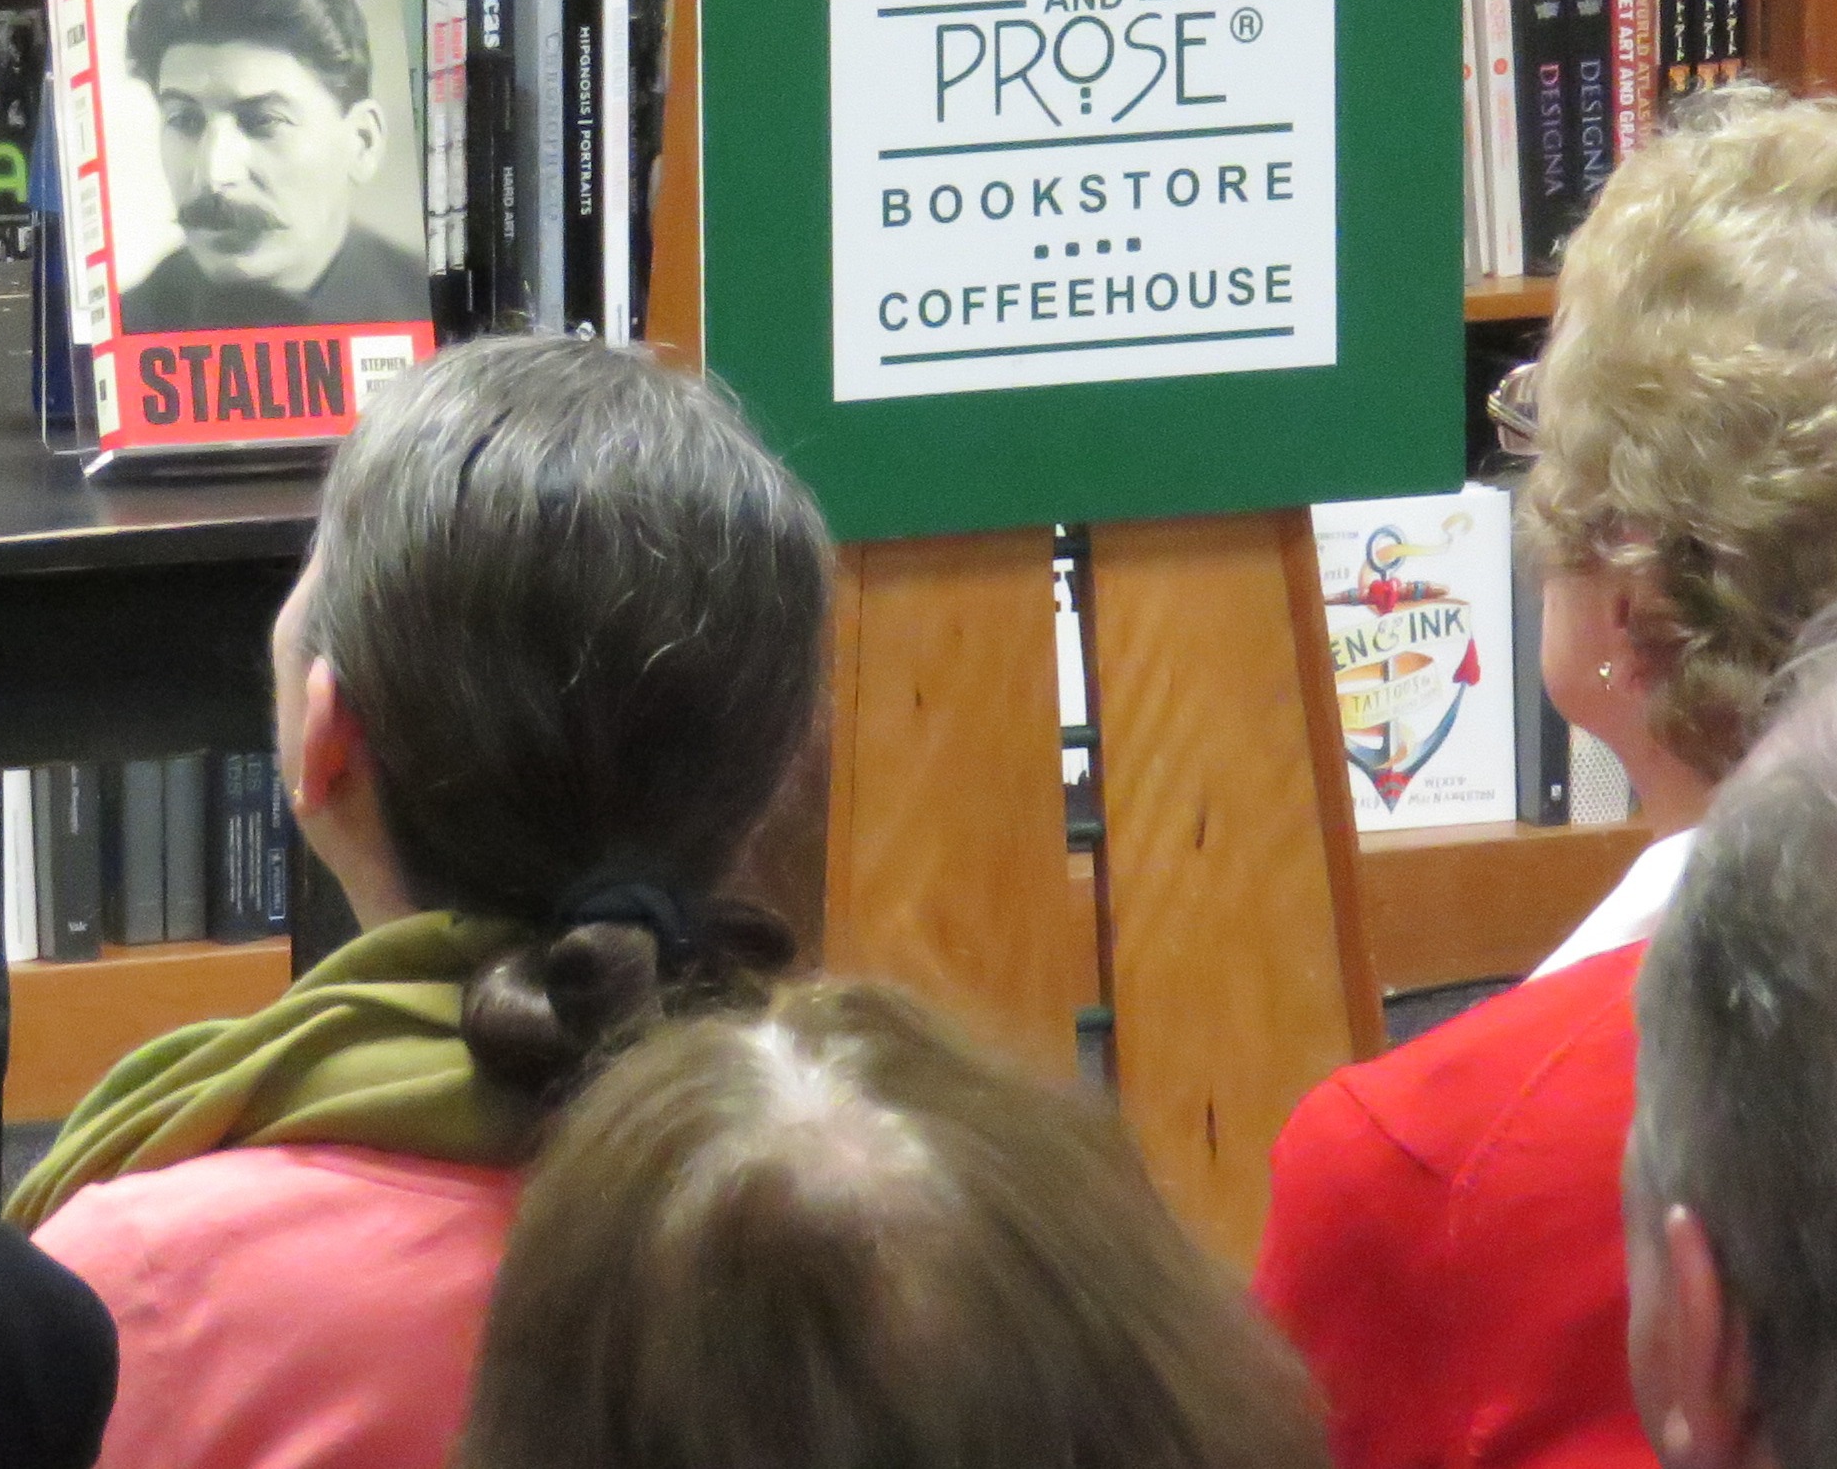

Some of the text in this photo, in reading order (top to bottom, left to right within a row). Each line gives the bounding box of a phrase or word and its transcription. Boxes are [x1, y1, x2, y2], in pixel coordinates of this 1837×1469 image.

[1619, 25, 1634, 62] ART
[1620, 67, 1635, 106] AND
[579, 25, 593, 217] HIPGNOSIS PORTRAITS
[1538, 62, 1564, 197] DESIGNA
[1579, 59, 1605, 194] DESIGNA
[882, 161, 1294, 228] BOOKSTORE
[878, 264, 1293, 332] COFFEEHOUSE
[138, 338, 347, 426] STALIN
[1331, 628, 1368, 672] EN
[1408, 606, 1465, 644] INK
